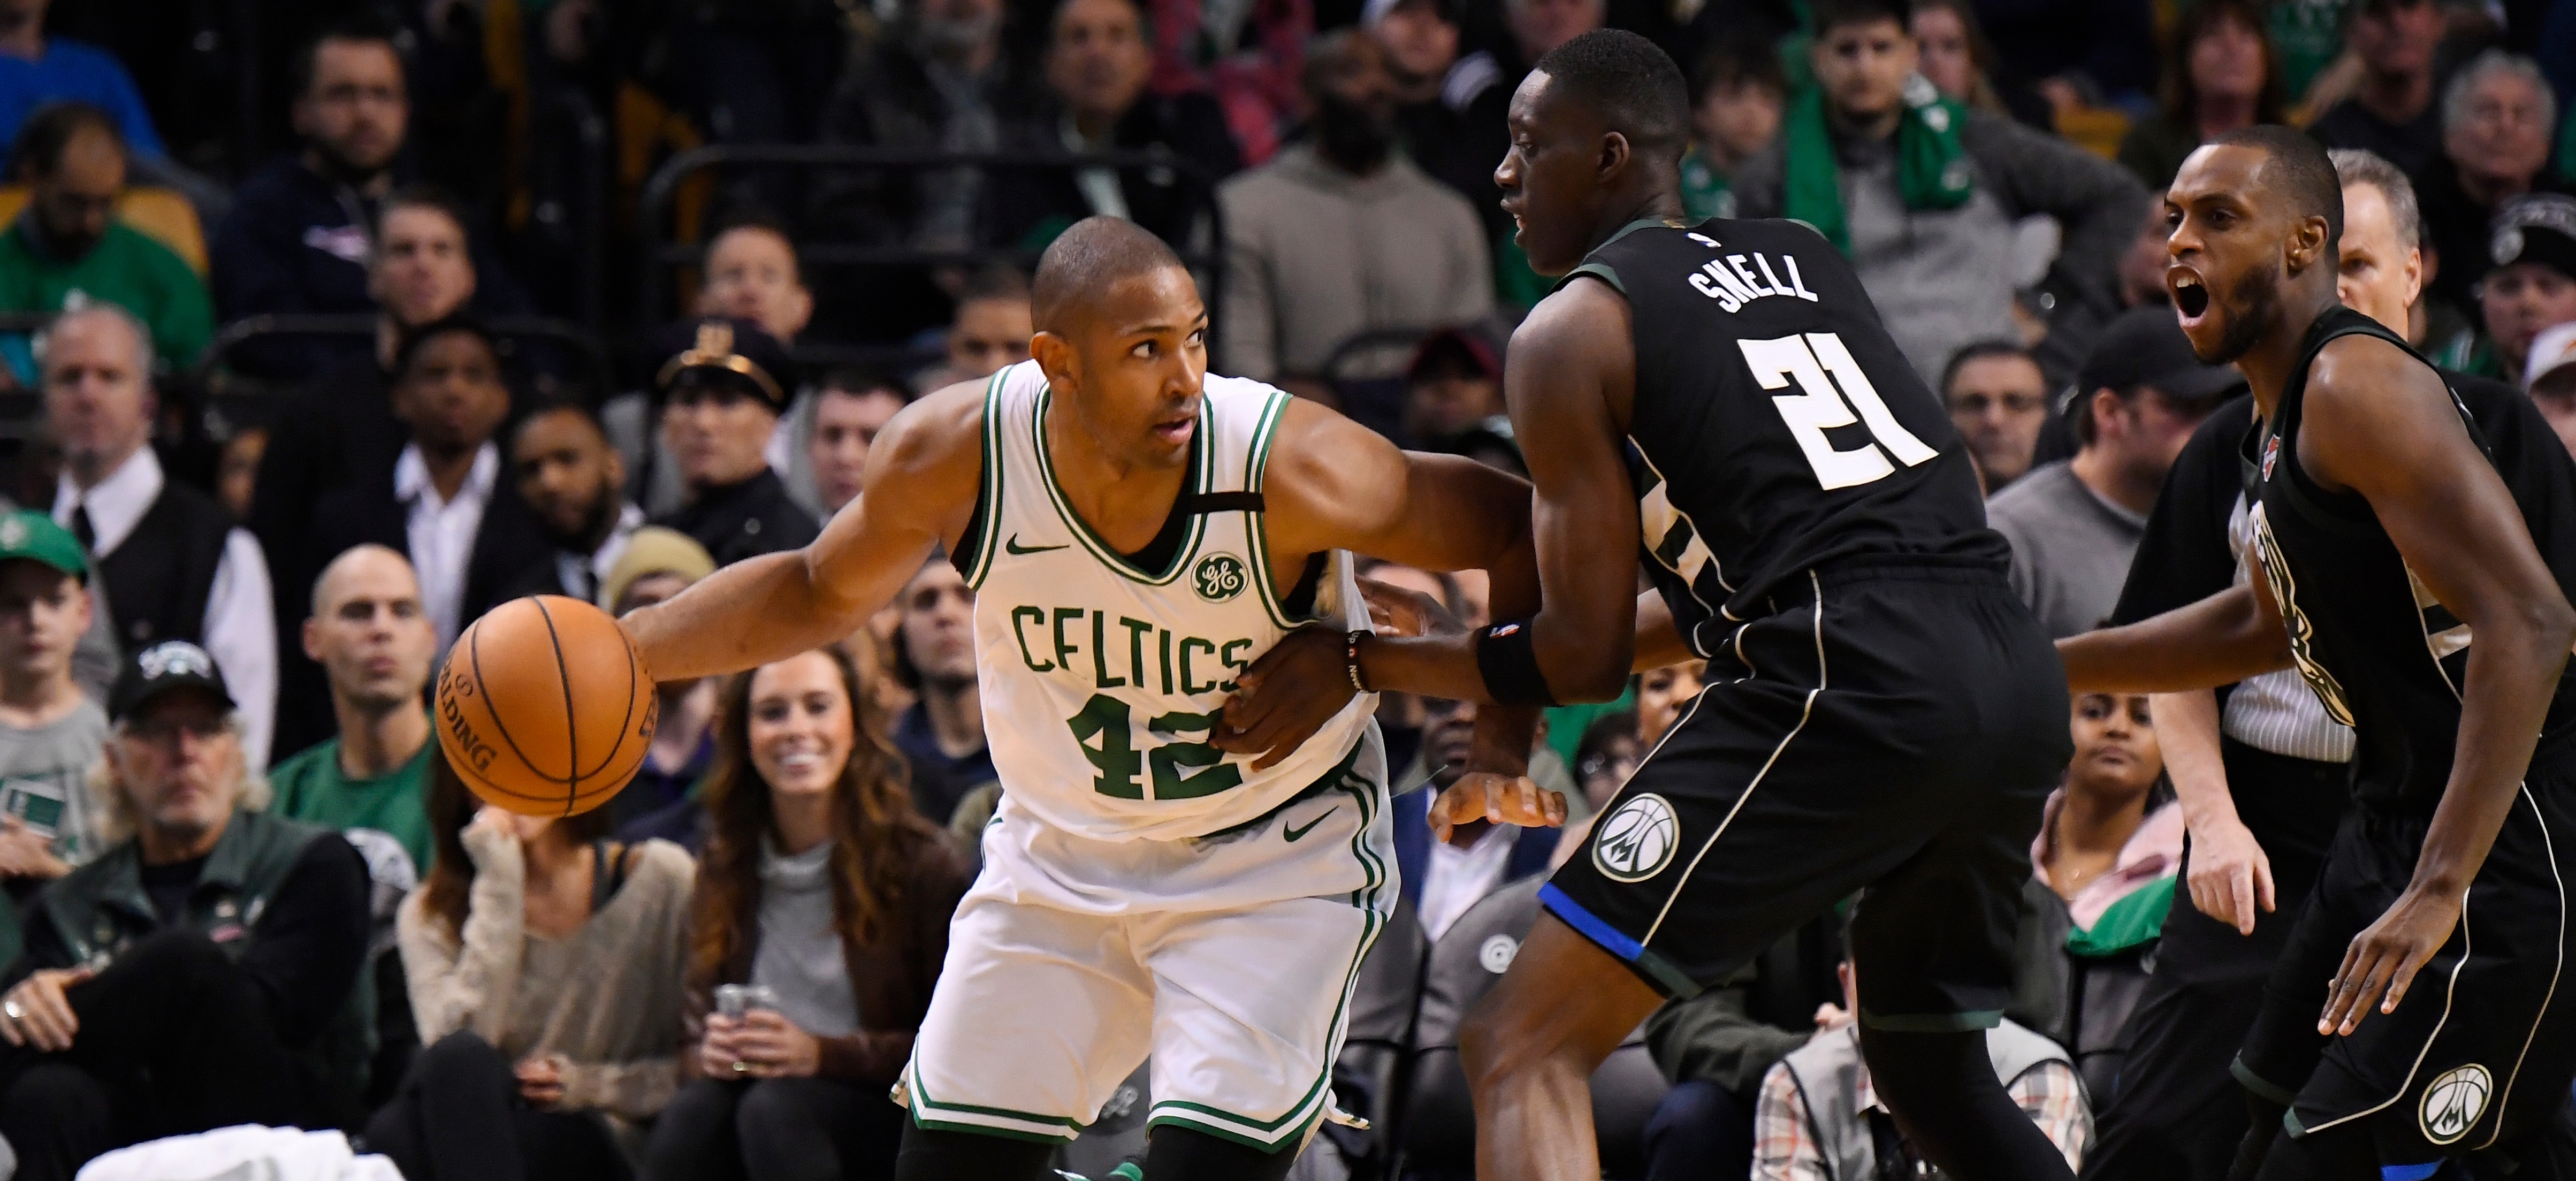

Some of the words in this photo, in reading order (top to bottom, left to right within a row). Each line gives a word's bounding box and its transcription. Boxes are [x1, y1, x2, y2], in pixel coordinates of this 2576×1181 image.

[1688, 252, 1819, 314] SNELL
[1737, 332, 1940, 490] 21
[1011, 605, 1253, 696] CELTICS
[1066, 694, 1243, 800] 42
